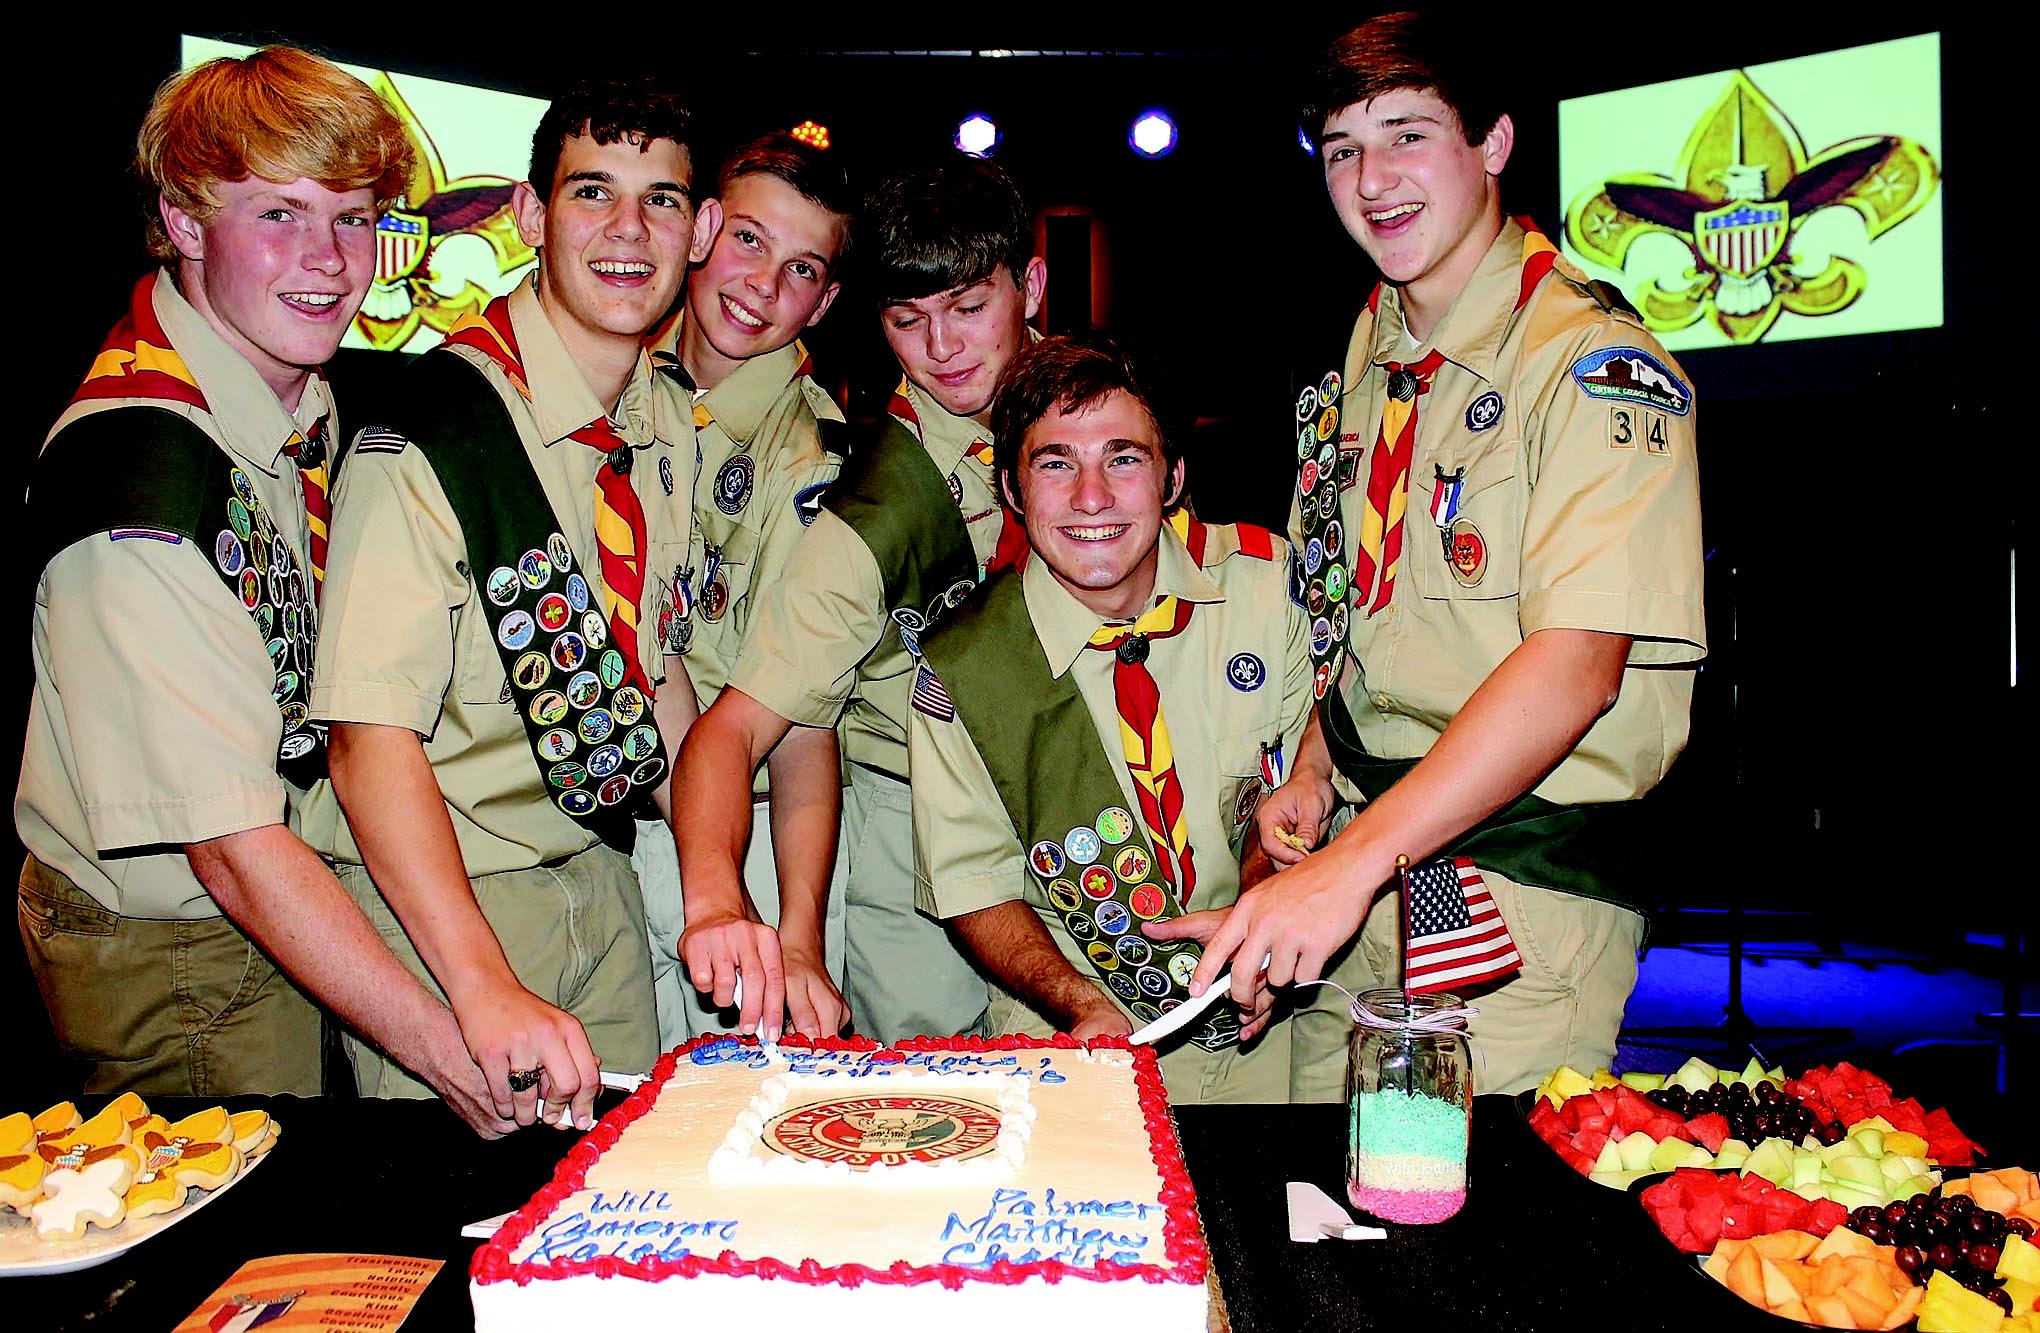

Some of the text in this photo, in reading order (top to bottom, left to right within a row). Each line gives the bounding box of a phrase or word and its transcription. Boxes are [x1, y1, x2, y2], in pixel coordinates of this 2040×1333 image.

[814, 1100, 983, 1118] EAGLE SCOUT
[782, 1136, 872, 1164] SCOUTS
[881, 1152, 917, 1165] OF
[922, 1125, 998, 1158] AMERICA
[591, 1190, 672, 1214] Will
[989, 1188, 1162, 1220] Palmer
[541, 1212, 738, 1242] Cameron
[940, 1212, 1148, 1248] Matthew
[347, 1256, 430, 1269] Trustworthy
[388, 1267, 424, 1276] Loyal
[368, 1274, 418, 1285] Helpful
[353, 1282, 411, 1293] Friendly
[331, 1289, 403, 1301] Courteous
[365, 1302, 398, 1310] Kind
[325, 1308, 391, 1321] Obedient
[319, 1317, 385, 1329] Cheerful
